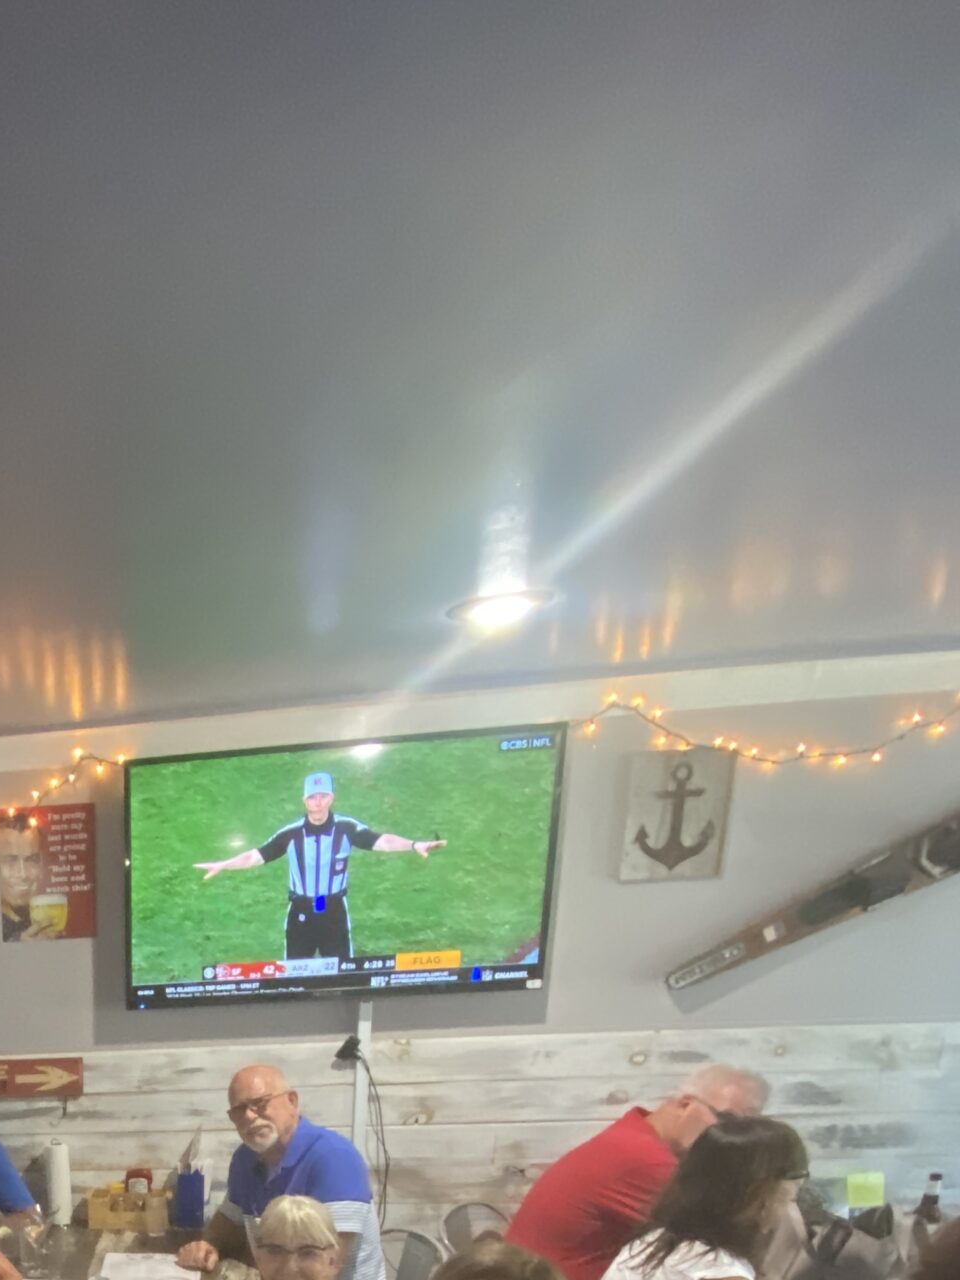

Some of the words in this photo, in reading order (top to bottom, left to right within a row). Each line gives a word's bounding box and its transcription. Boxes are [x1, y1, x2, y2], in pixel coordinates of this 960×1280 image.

[509, 740, 528, 749] CBS
[533, 738, 551, 748] NFL
[413, 956, 441, 966] FLAG
[262, 965, 275, 975] 42
[324, 962, 335, 971] 22
[494, 971, 528, 979] CHANNEL
